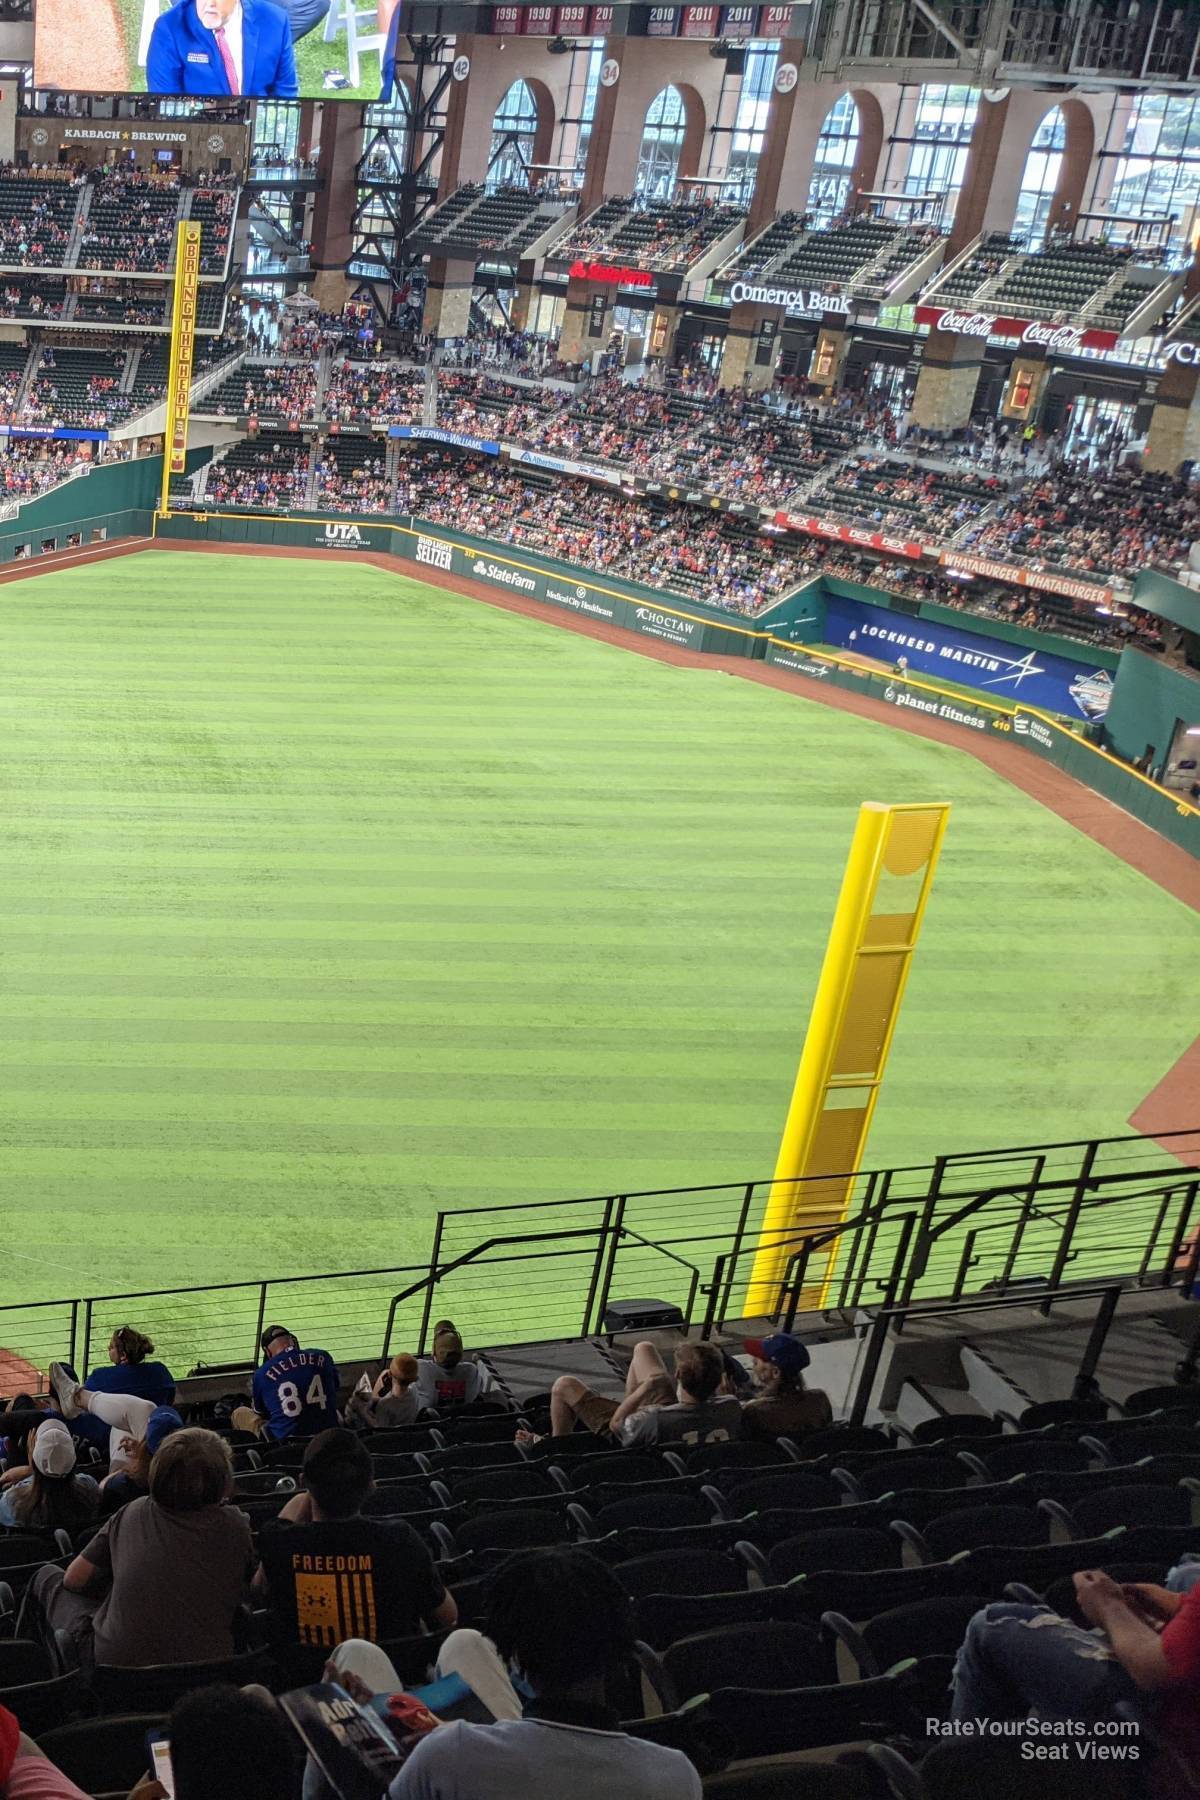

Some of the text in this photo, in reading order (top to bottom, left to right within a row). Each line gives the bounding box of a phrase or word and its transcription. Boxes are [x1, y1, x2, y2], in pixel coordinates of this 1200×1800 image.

[496, 8, 517, 20] 1996
[528, 7, 551, 20] 1998
[561, 7, 584, 20] 1999
[596, 7, 613, 20] 201
[650, 8, 674, 21] 2010
[688, 7, 712, 21] 2011
[727, 7, 752, 21] 2011
[454, 61, 468, 76] 42
[603, 63, 617, 80] 34
[778, 70, 795, 88] 26
[64, 129, 187, 142] KARBACH BREWING
[184, 246, 196, 314] BRING
[807, 291, 853, 314] Bank
[937, 310, 997, 337] Coca-Cola
[181, 320, 191, 359] THE
[1022, 322, 1087, 349] Coca-Cola
[177, 365, 188, 418] HEAT
[532, 455, 565, 470] Albertsons
[787, 514, 810, 526] DEX
[817, 522, 841, 534] DEX
[325, 524, 361, 540] UTA
[849, 530, 872, 542] DEX
[432, 540, 452, 552] LIGHT
[881, 537, 906, 550] DEX
[416, 544, 452, 570] SELTZER
[944, 554, 1020, 582] WHATABURGER
[1024, 573, 1106, 602] WHATABURGER
[546, 589, 568, 603] Medical
[581, 600, 613, 618] Healthcare
[642, 608, 694, 635] CHOCTAW
[861, 624, 999, 671] LOCKHEED MARTIN
[896, 693, 986, 729] planet fitness
[992, 719, 1010, 732] 410
[266, 1353, 325, 1381] FIELDER
[278, 1374, 327, 1417] 84
[292, 1554, 372, 1571] FREEDOM
